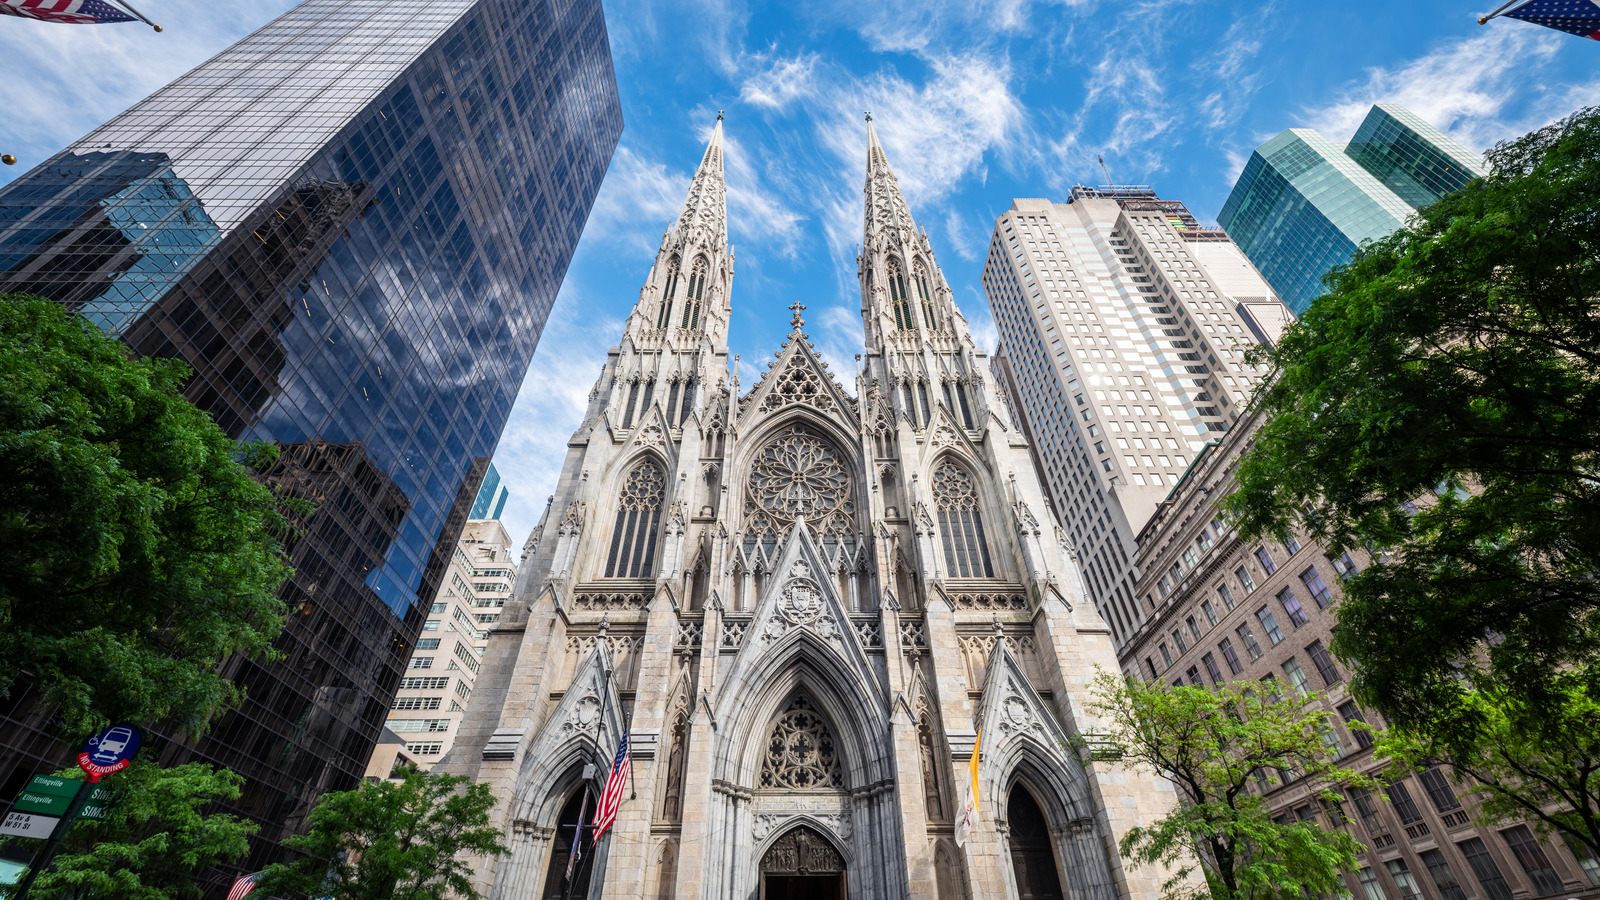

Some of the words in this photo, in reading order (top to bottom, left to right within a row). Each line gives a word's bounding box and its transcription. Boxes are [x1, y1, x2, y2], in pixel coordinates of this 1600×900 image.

[80, 755, 90, 765] NO
[86, 762, 124, 773] STANDING
[4, 820, 13, 828] W
